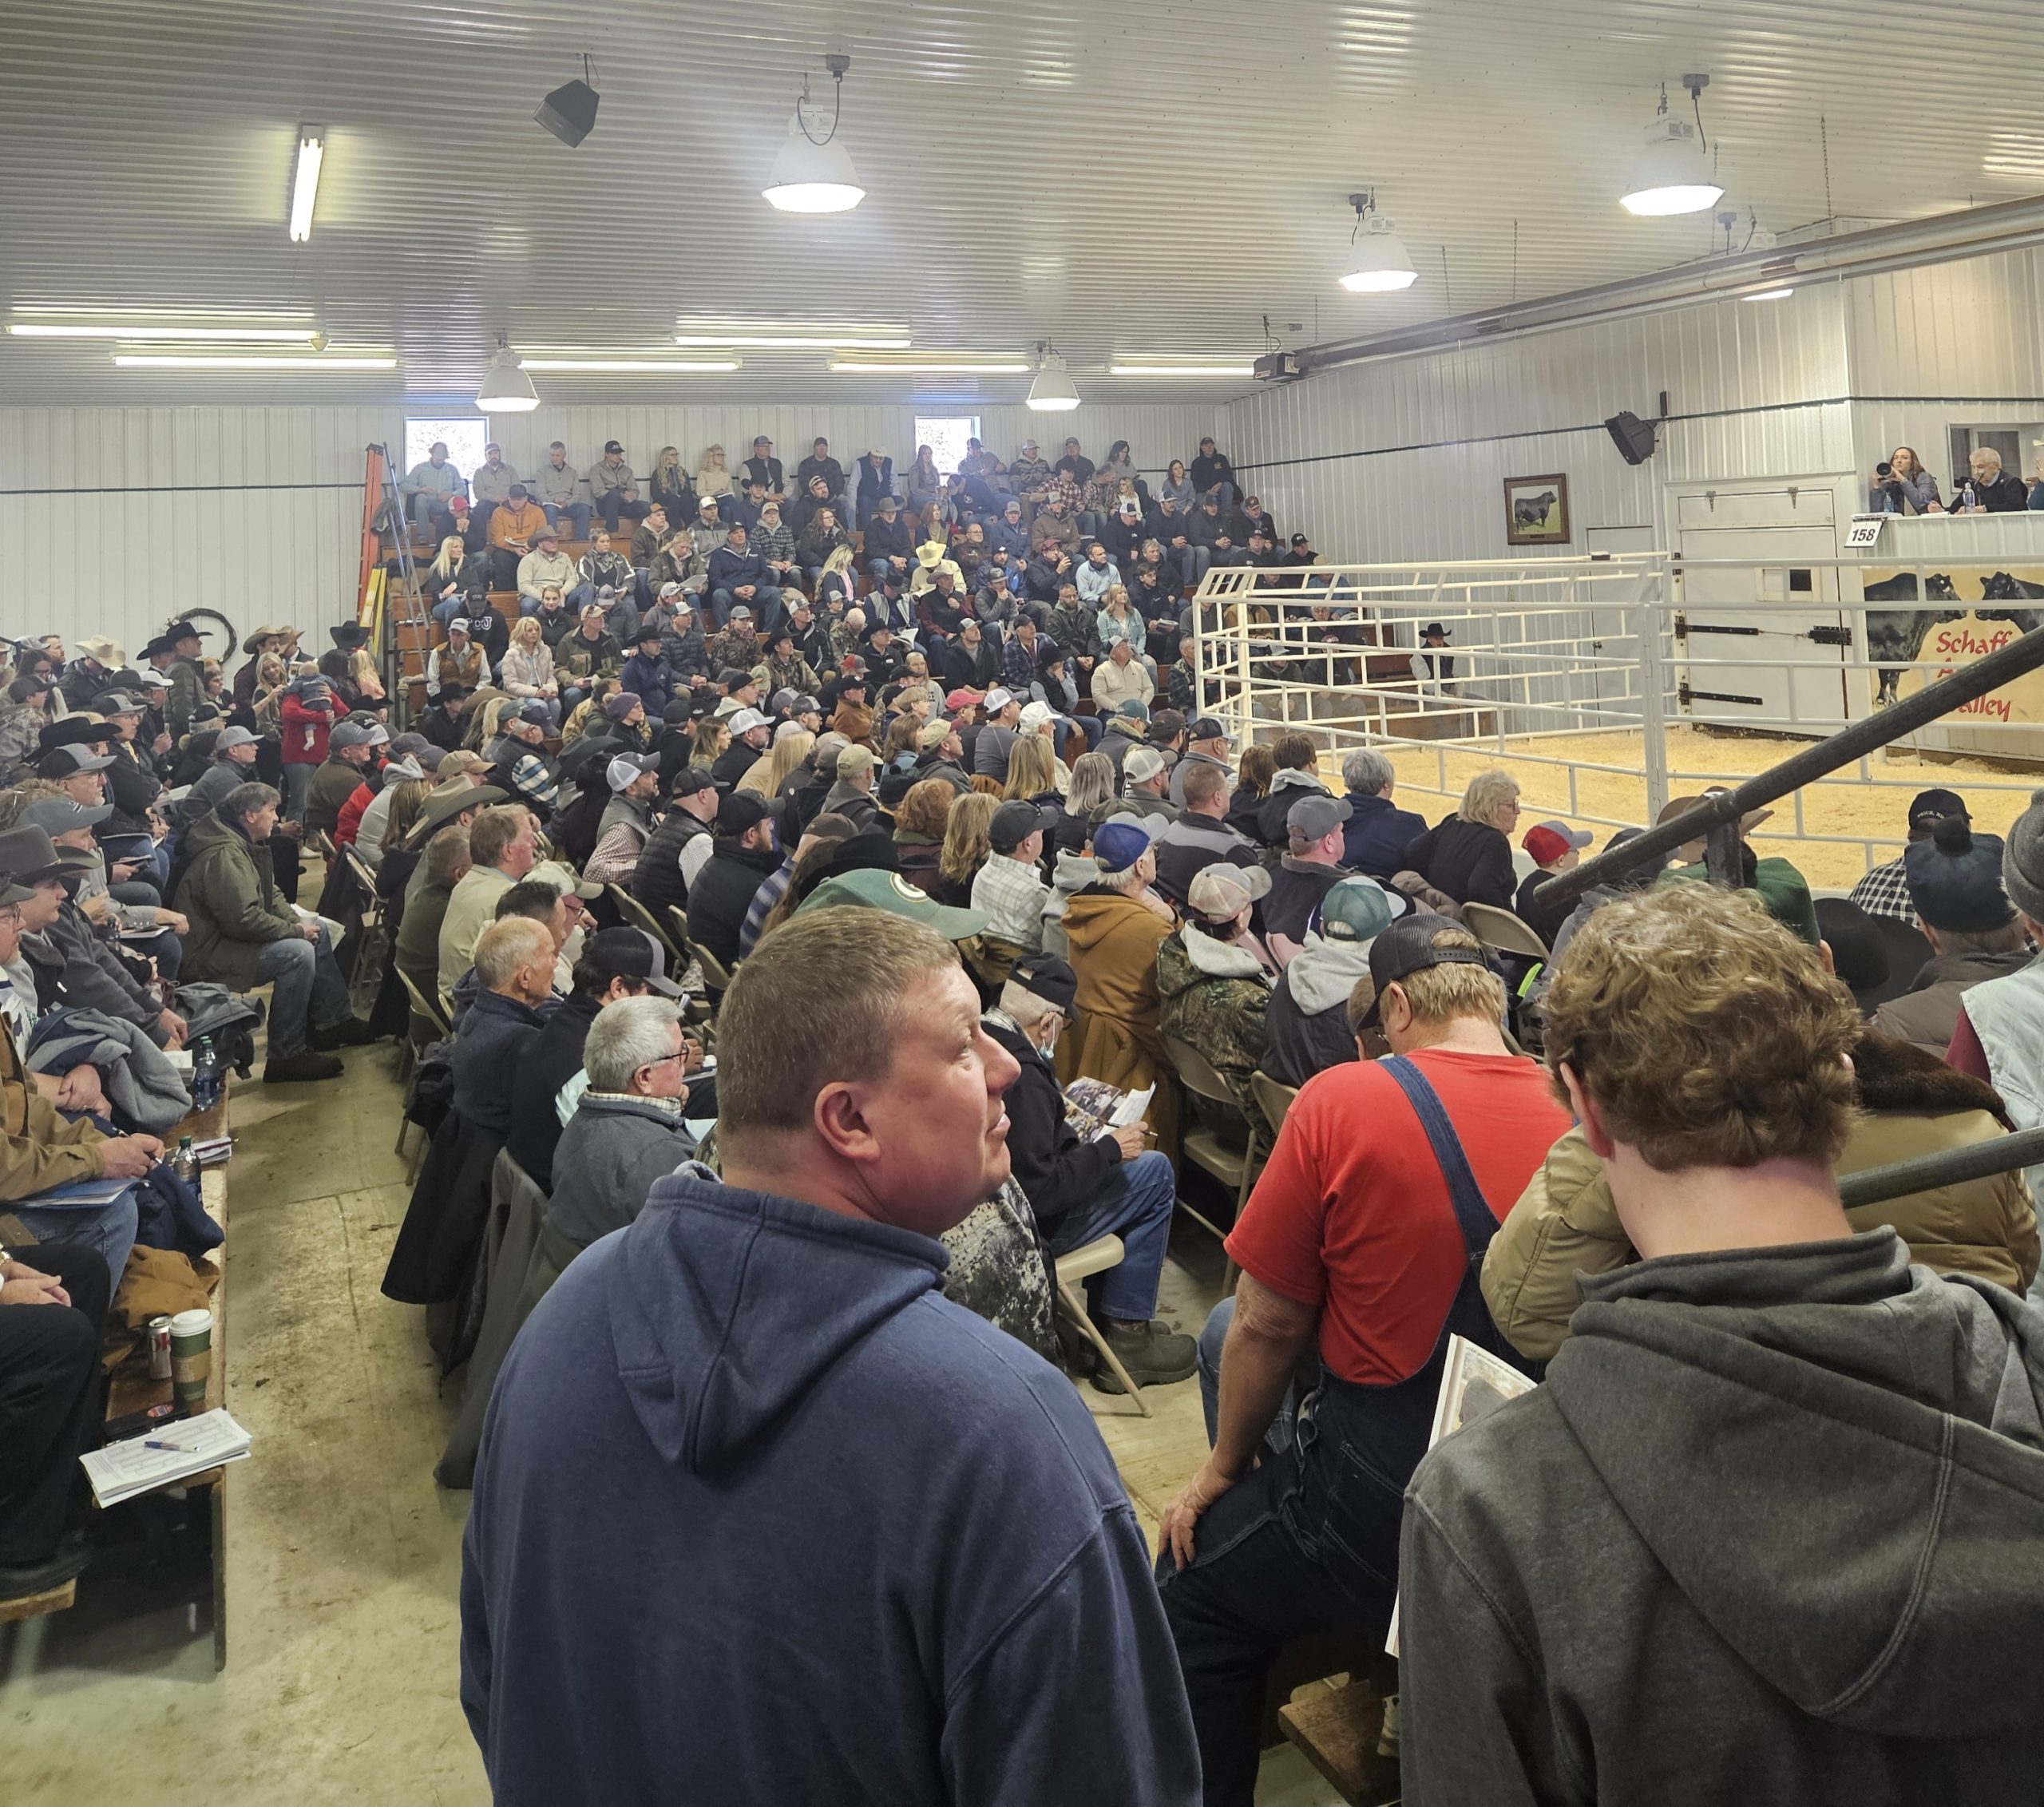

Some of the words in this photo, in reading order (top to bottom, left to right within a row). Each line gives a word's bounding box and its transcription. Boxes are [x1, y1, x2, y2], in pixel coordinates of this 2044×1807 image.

[1852, 528, 1876, 541] 158
[1935, 629, 2013, 654] Schaff
[1958, 693, 2011, 722] alley
